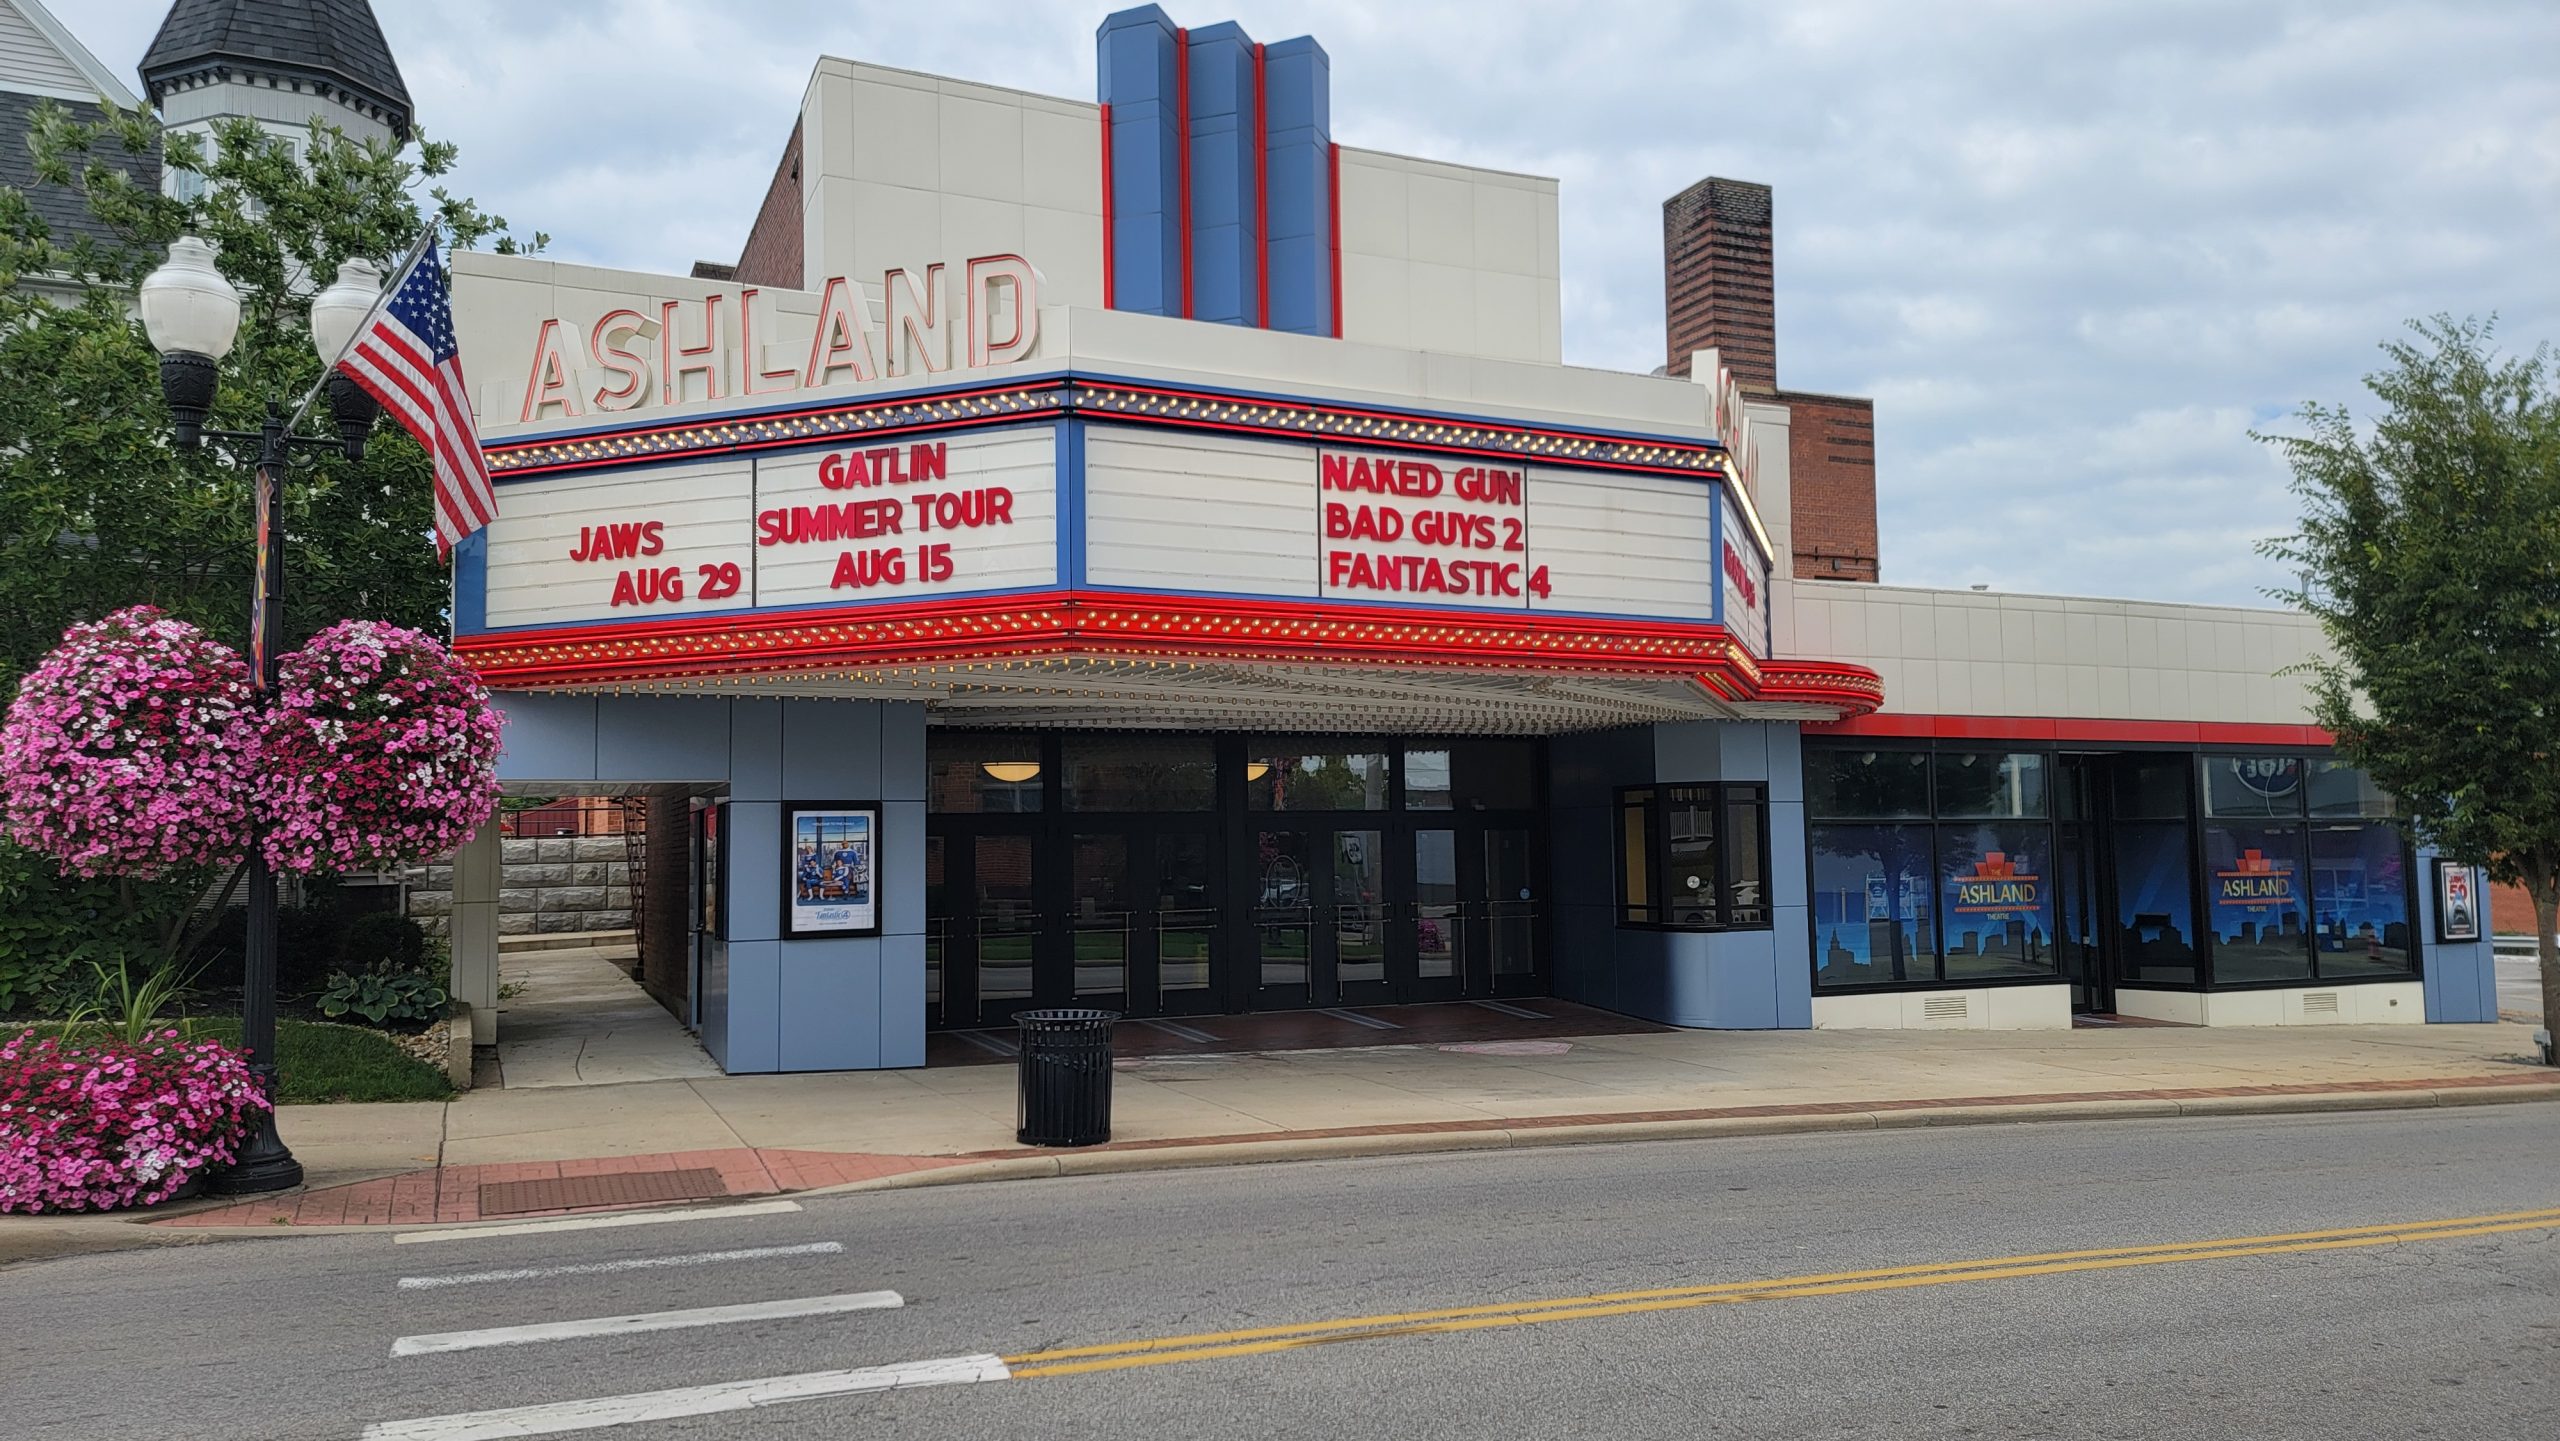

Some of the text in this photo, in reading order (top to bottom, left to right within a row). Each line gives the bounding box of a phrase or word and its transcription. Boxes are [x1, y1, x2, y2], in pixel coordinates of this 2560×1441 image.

[519, 253, 1043, 423] ASHLAND
[818, 442, 946, 490] GATLIN
[1321, 453, 1522, 506] NAKED GUN
[757, 486, 1013, 546] SUMMER TOUR
[1325, 502, 1524, 551] BAD GUYS 2
[569, 520, 664, 563] JAWS
[610, 561, 742, 608] AUG 29
[830, 542, 955, 590] AUG 15
[1328, 550, 1552, 600] FANTASTIC 4
[1958, 883, 2036, 904] ASHLAND
[2222, 879, 2289, 897] ASHLAND
